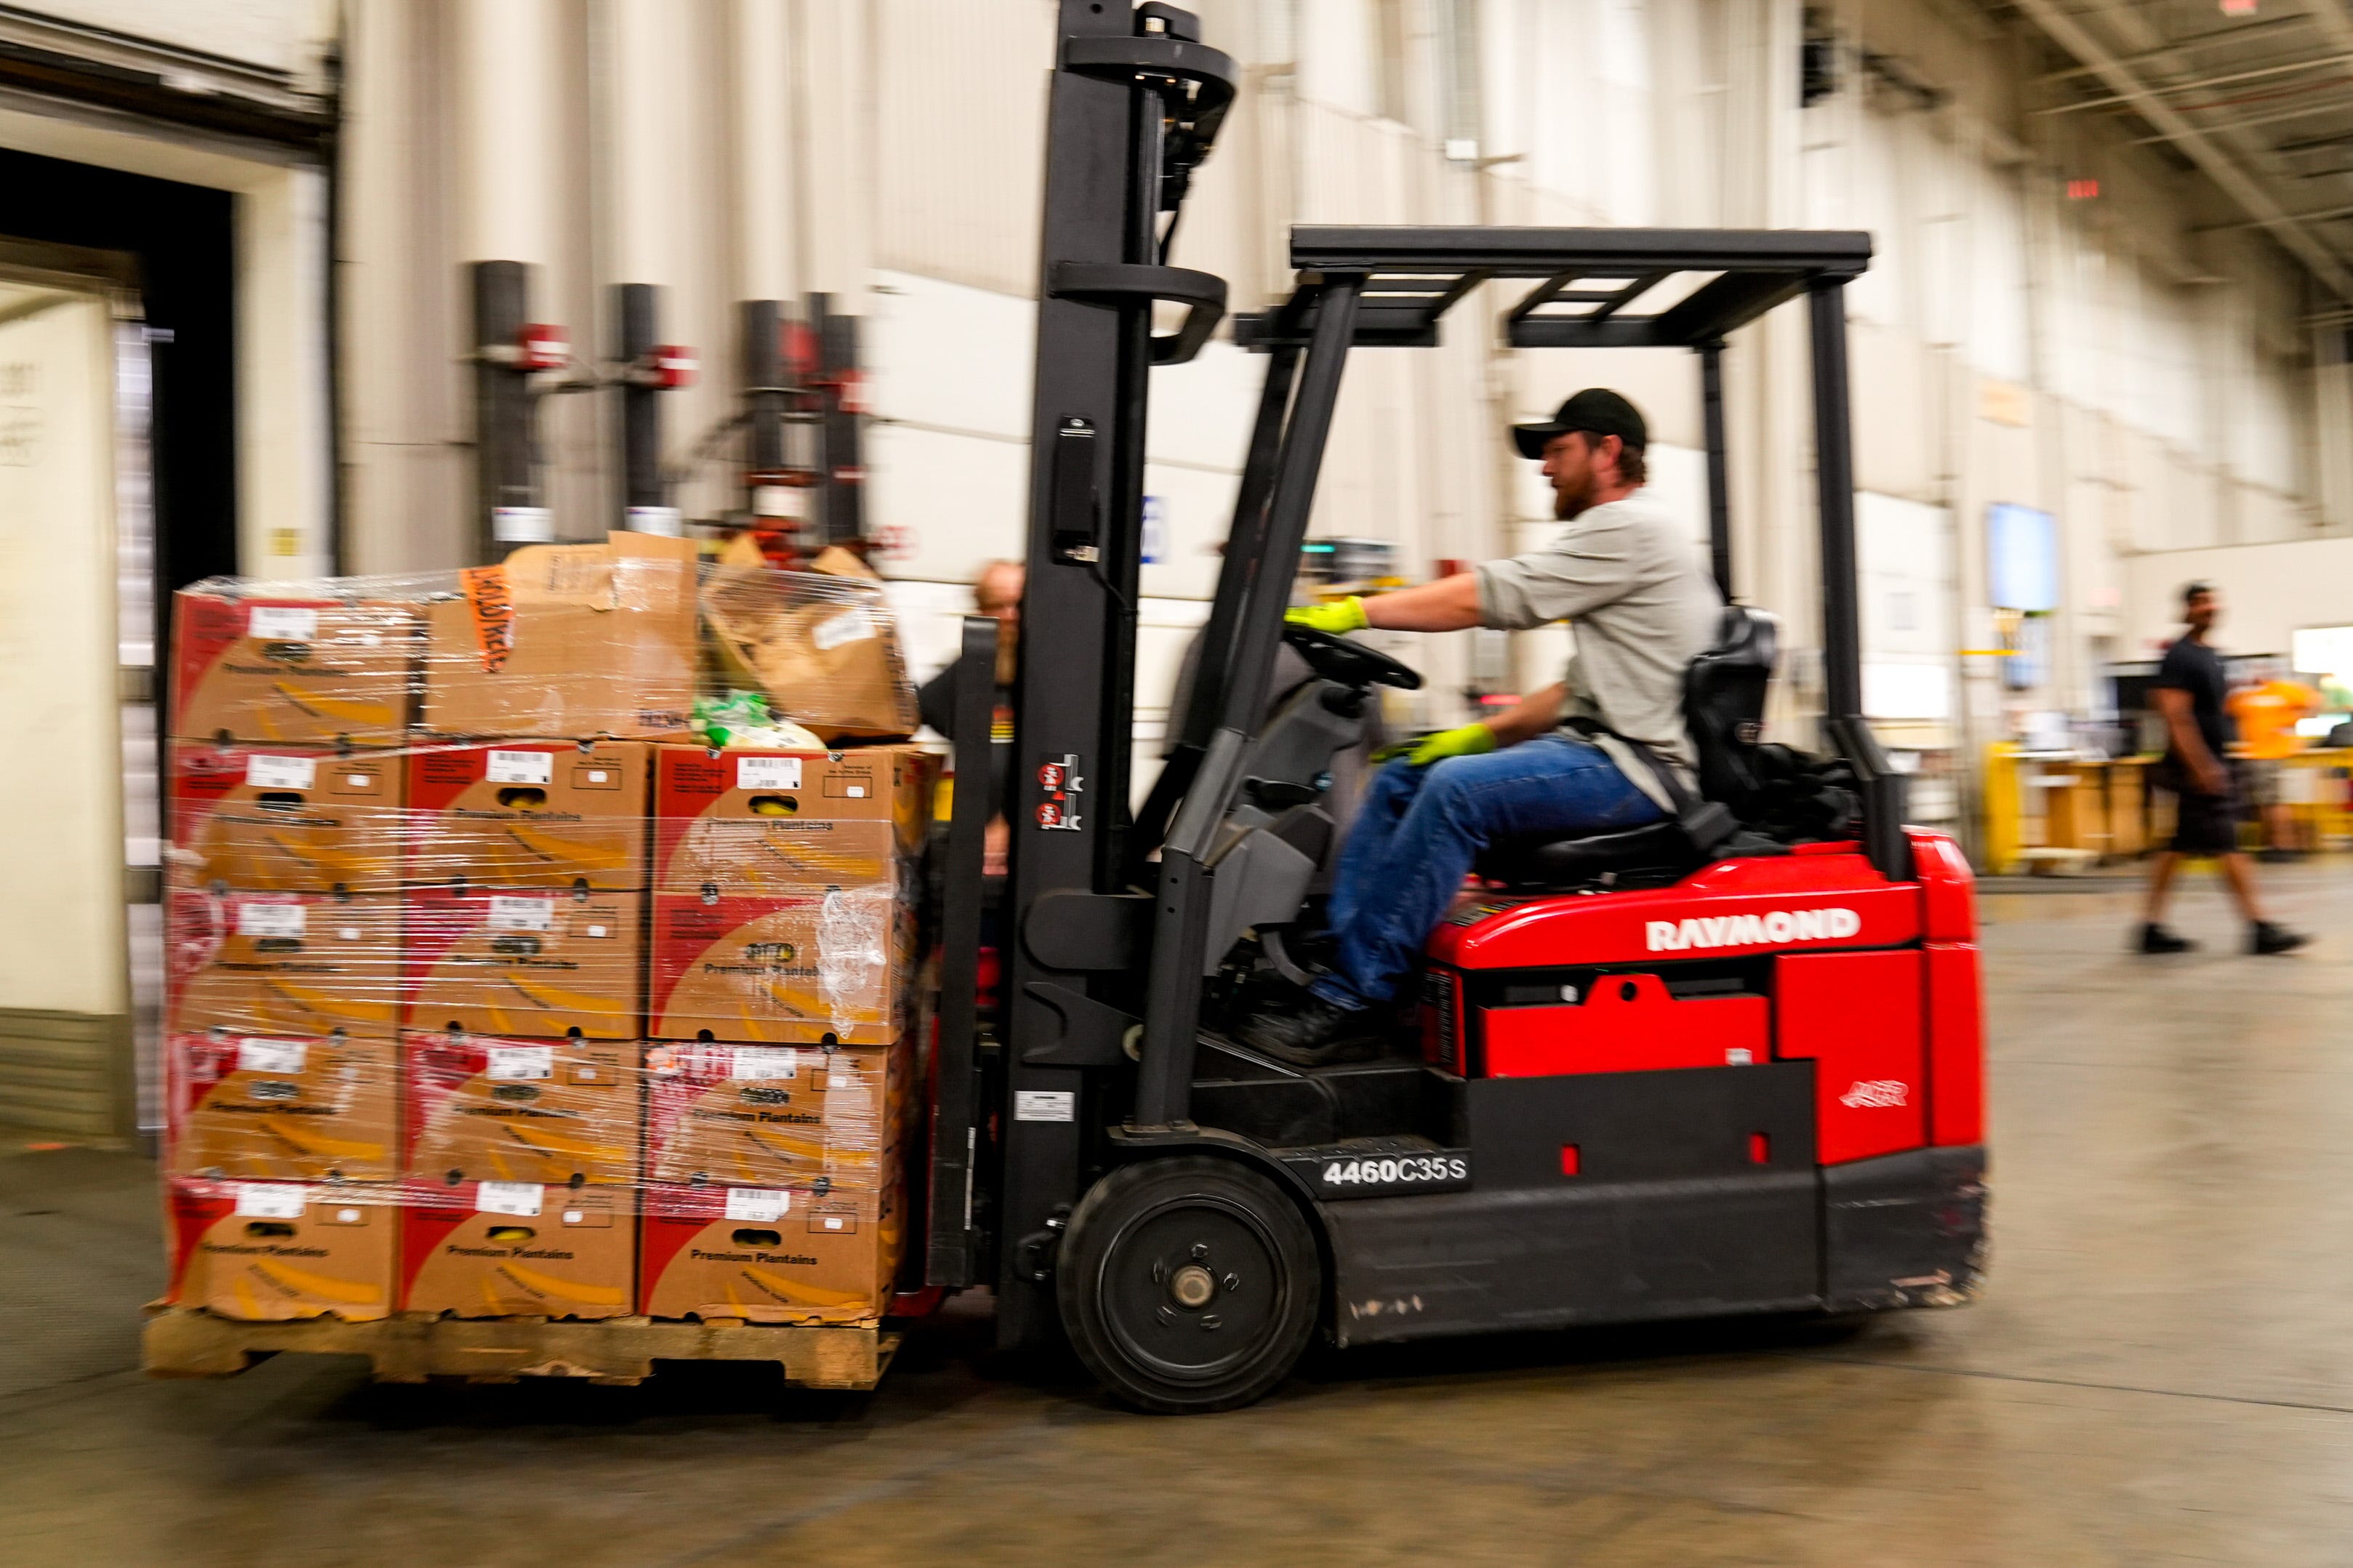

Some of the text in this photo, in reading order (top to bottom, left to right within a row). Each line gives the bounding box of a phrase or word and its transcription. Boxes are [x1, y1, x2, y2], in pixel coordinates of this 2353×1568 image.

[1645, 907, 1861, 952] RAYMOND
[759, 1111, 821, 1125] Plantains
[1323, 1157, 1467, 1185] 4460C35S
[446, 1245, 575, 1260] Premium Plantains
[691, 1249, 818, 1266] Premium Plantains
